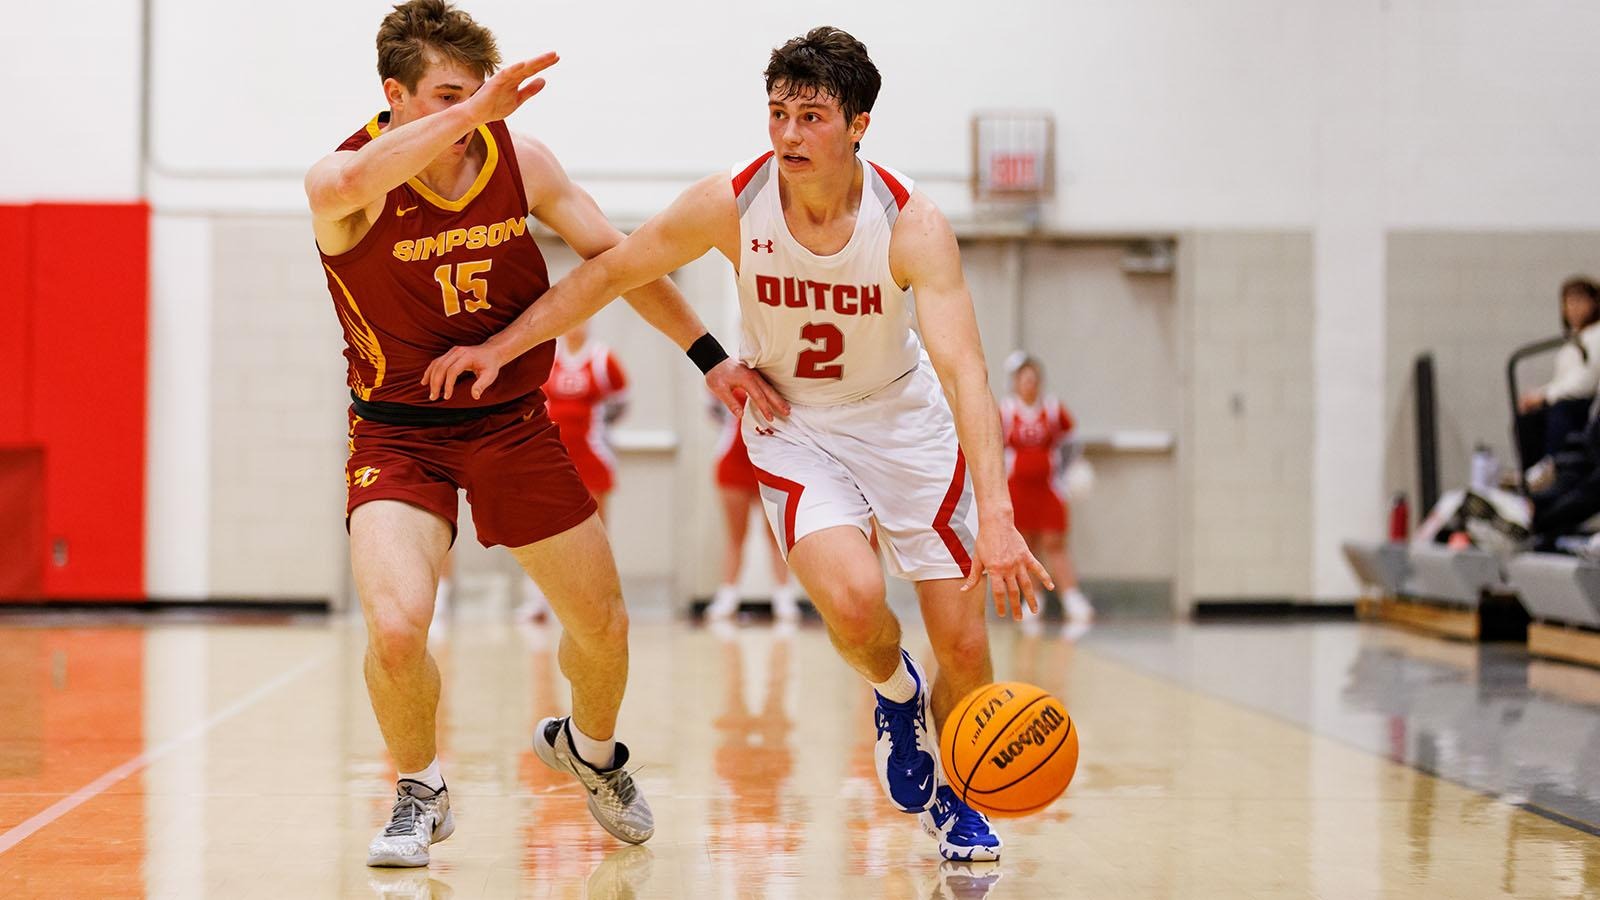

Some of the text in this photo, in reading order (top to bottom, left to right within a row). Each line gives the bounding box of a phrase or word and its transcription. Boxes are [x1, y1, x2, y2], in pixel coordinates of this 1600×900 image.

[393, 216, 527, 262] SIMPSON
[434, 259, 492, 318] 15
[755, 274, 883, 316] DUTCH
[794, 321, 845, 381] 2
[991, 705, 1064, 769] Wilson
